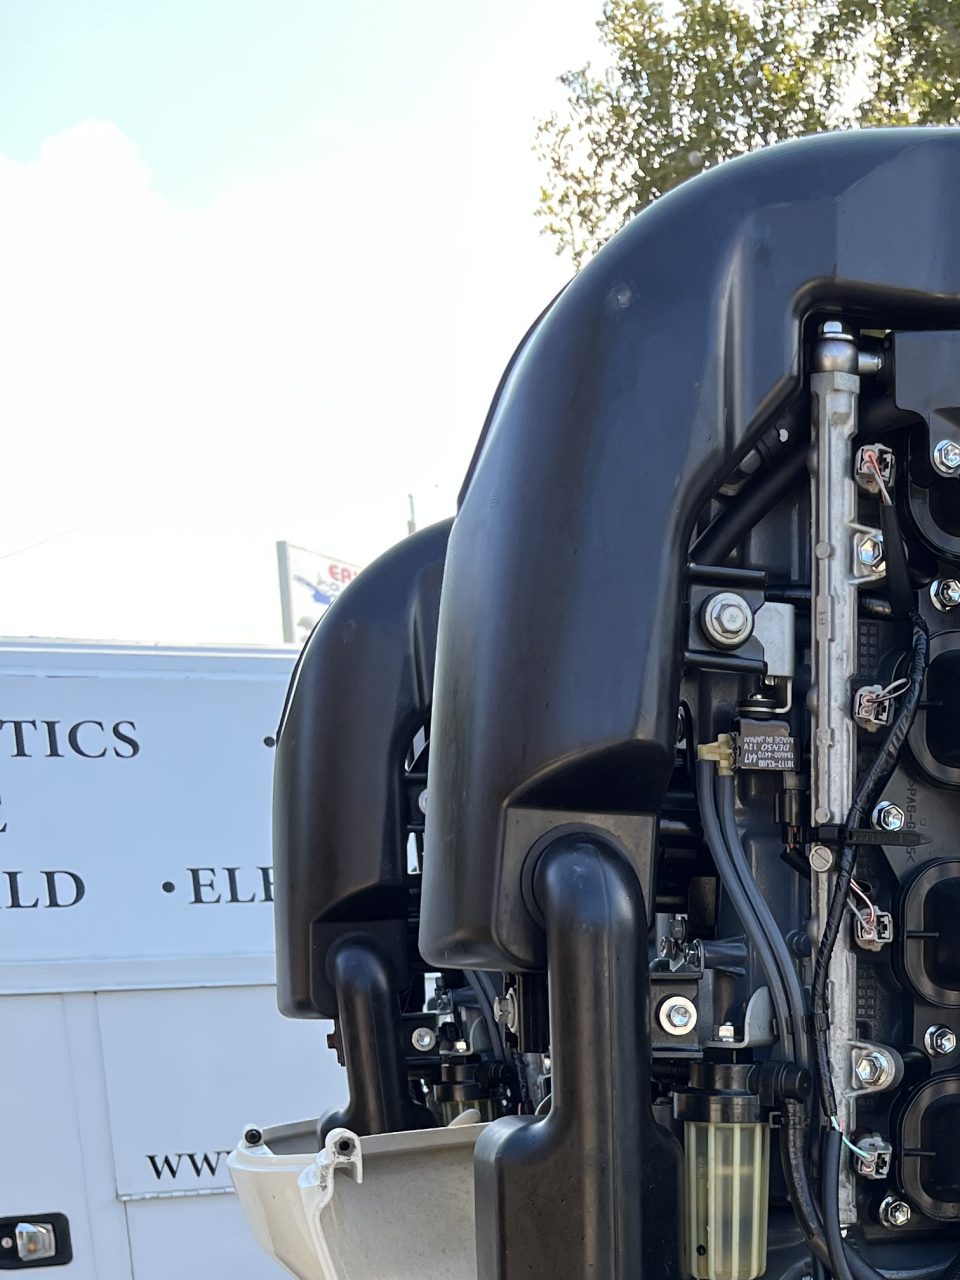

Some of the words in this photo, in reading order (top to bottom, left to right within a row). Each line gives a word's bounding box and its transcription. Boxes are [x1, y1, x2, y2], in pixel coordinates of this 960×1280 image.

[328, 565, 357, 583] EA
[0, 719, 140, 759] TICS
[765, 736, 774, 744] IN
[774, 736, 794, 744] MADE
[760, 743, 790, 751] DENSO
